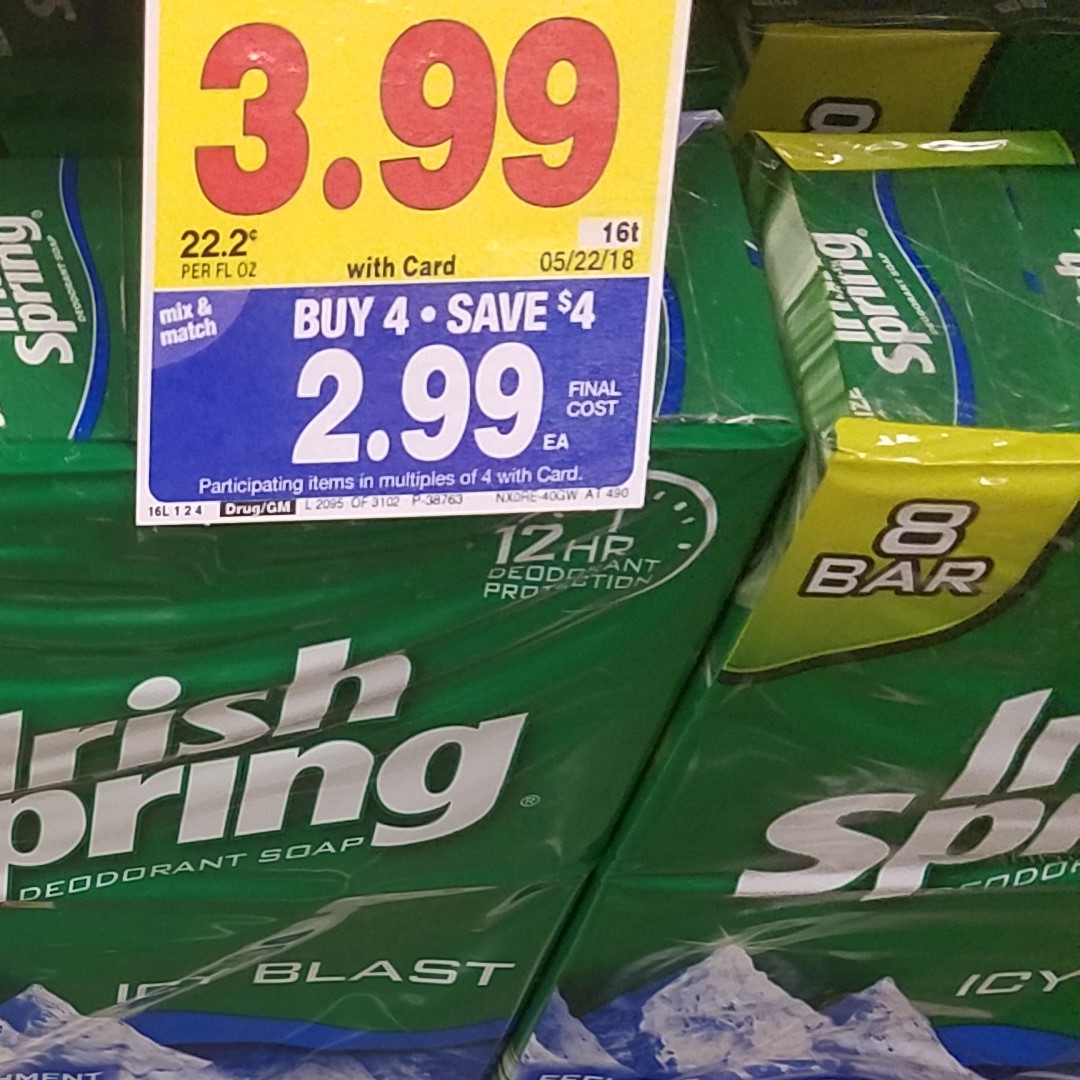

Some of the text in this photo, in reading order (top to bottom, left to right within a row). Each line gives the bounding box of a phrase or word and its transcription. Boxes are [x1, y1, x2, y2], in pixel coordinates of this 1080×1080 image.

[195, 17, 620, 215] 3.99
[603, 221, 639, 243] 16t
[182, 261, 257, 279] PER FL OZ
[347, 255, 456, 278] with Card
[540, 250, 634, 272] 05/22/18
[878, 251, 900, 278] SOAP
[159, 296, 213, 325] mix &
[293, 288, 596, 340] BUY 4 SAVE $4
[811, 231, 938, 375] Spring
[159, 317, 218, 346] match
[568, 380, 623, 399] FINAL
[291, 342, 544, 466] 2.99
[566, 400, 620, 418] COST
[542, 433, 570, 451] EA
[199, 465, 584, 496] Participating items in multiples of 4 with Card.
[606, 487, 630, 499] 490
[149, 505, 170, 517] 16L
[224, 502, 293, 517] Drug/GM
[315, 498, 345, 510] 2095
[350, 497, 368, 509] OF
[371, 496, 400, 508] 3102
[876, 501, 976, 556] 8
[495, 523, 564, 565] 12
[802, 556, 991, 595] BAR
[19, 836, 366, 903] DEODORANT SOAP
[252, 959, 517, 987] BLAST
[955, 969, 1080, 997] ICY
